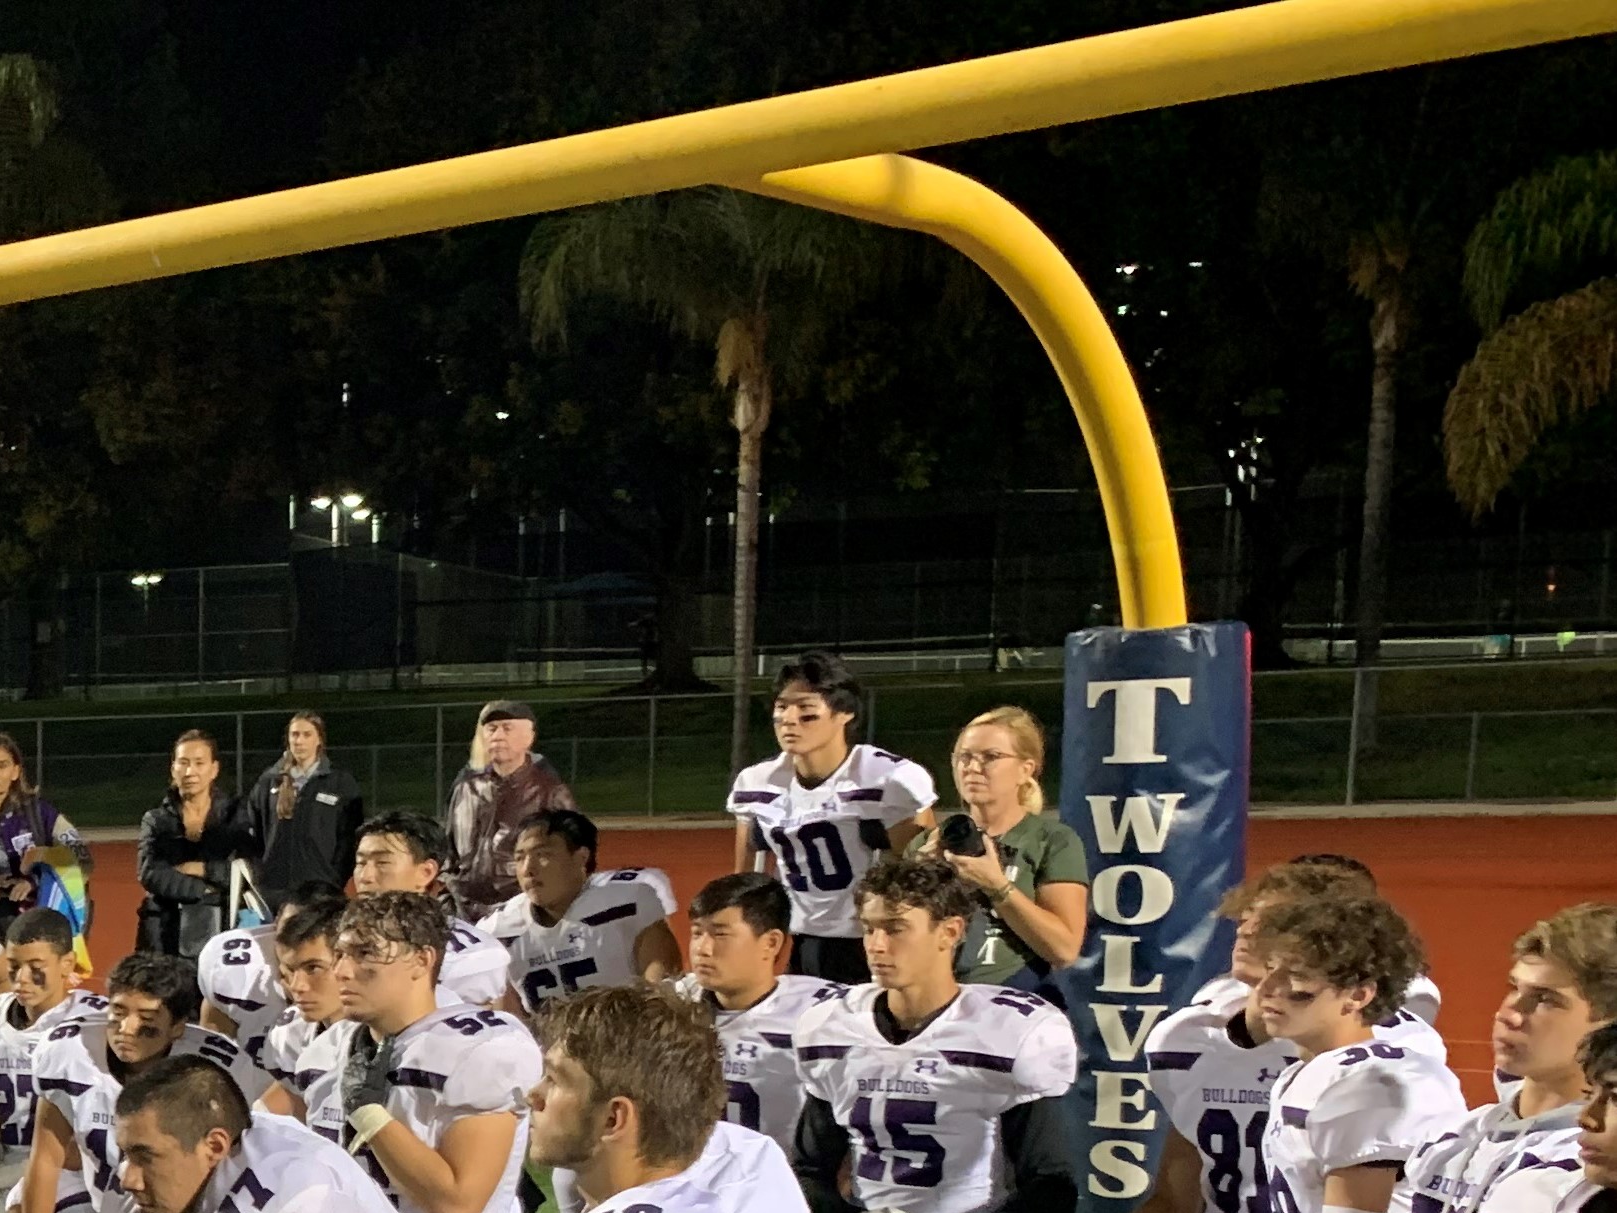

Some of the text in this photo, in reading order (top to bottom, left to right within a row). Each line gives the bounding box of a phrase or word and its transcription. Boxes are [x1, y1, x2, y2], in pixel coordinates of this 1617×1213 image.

[770, 820, 853, 892] 10
[857, 1079, 930, 1095] BULLDOGS
[849, 1097, 946, 1188] 15
